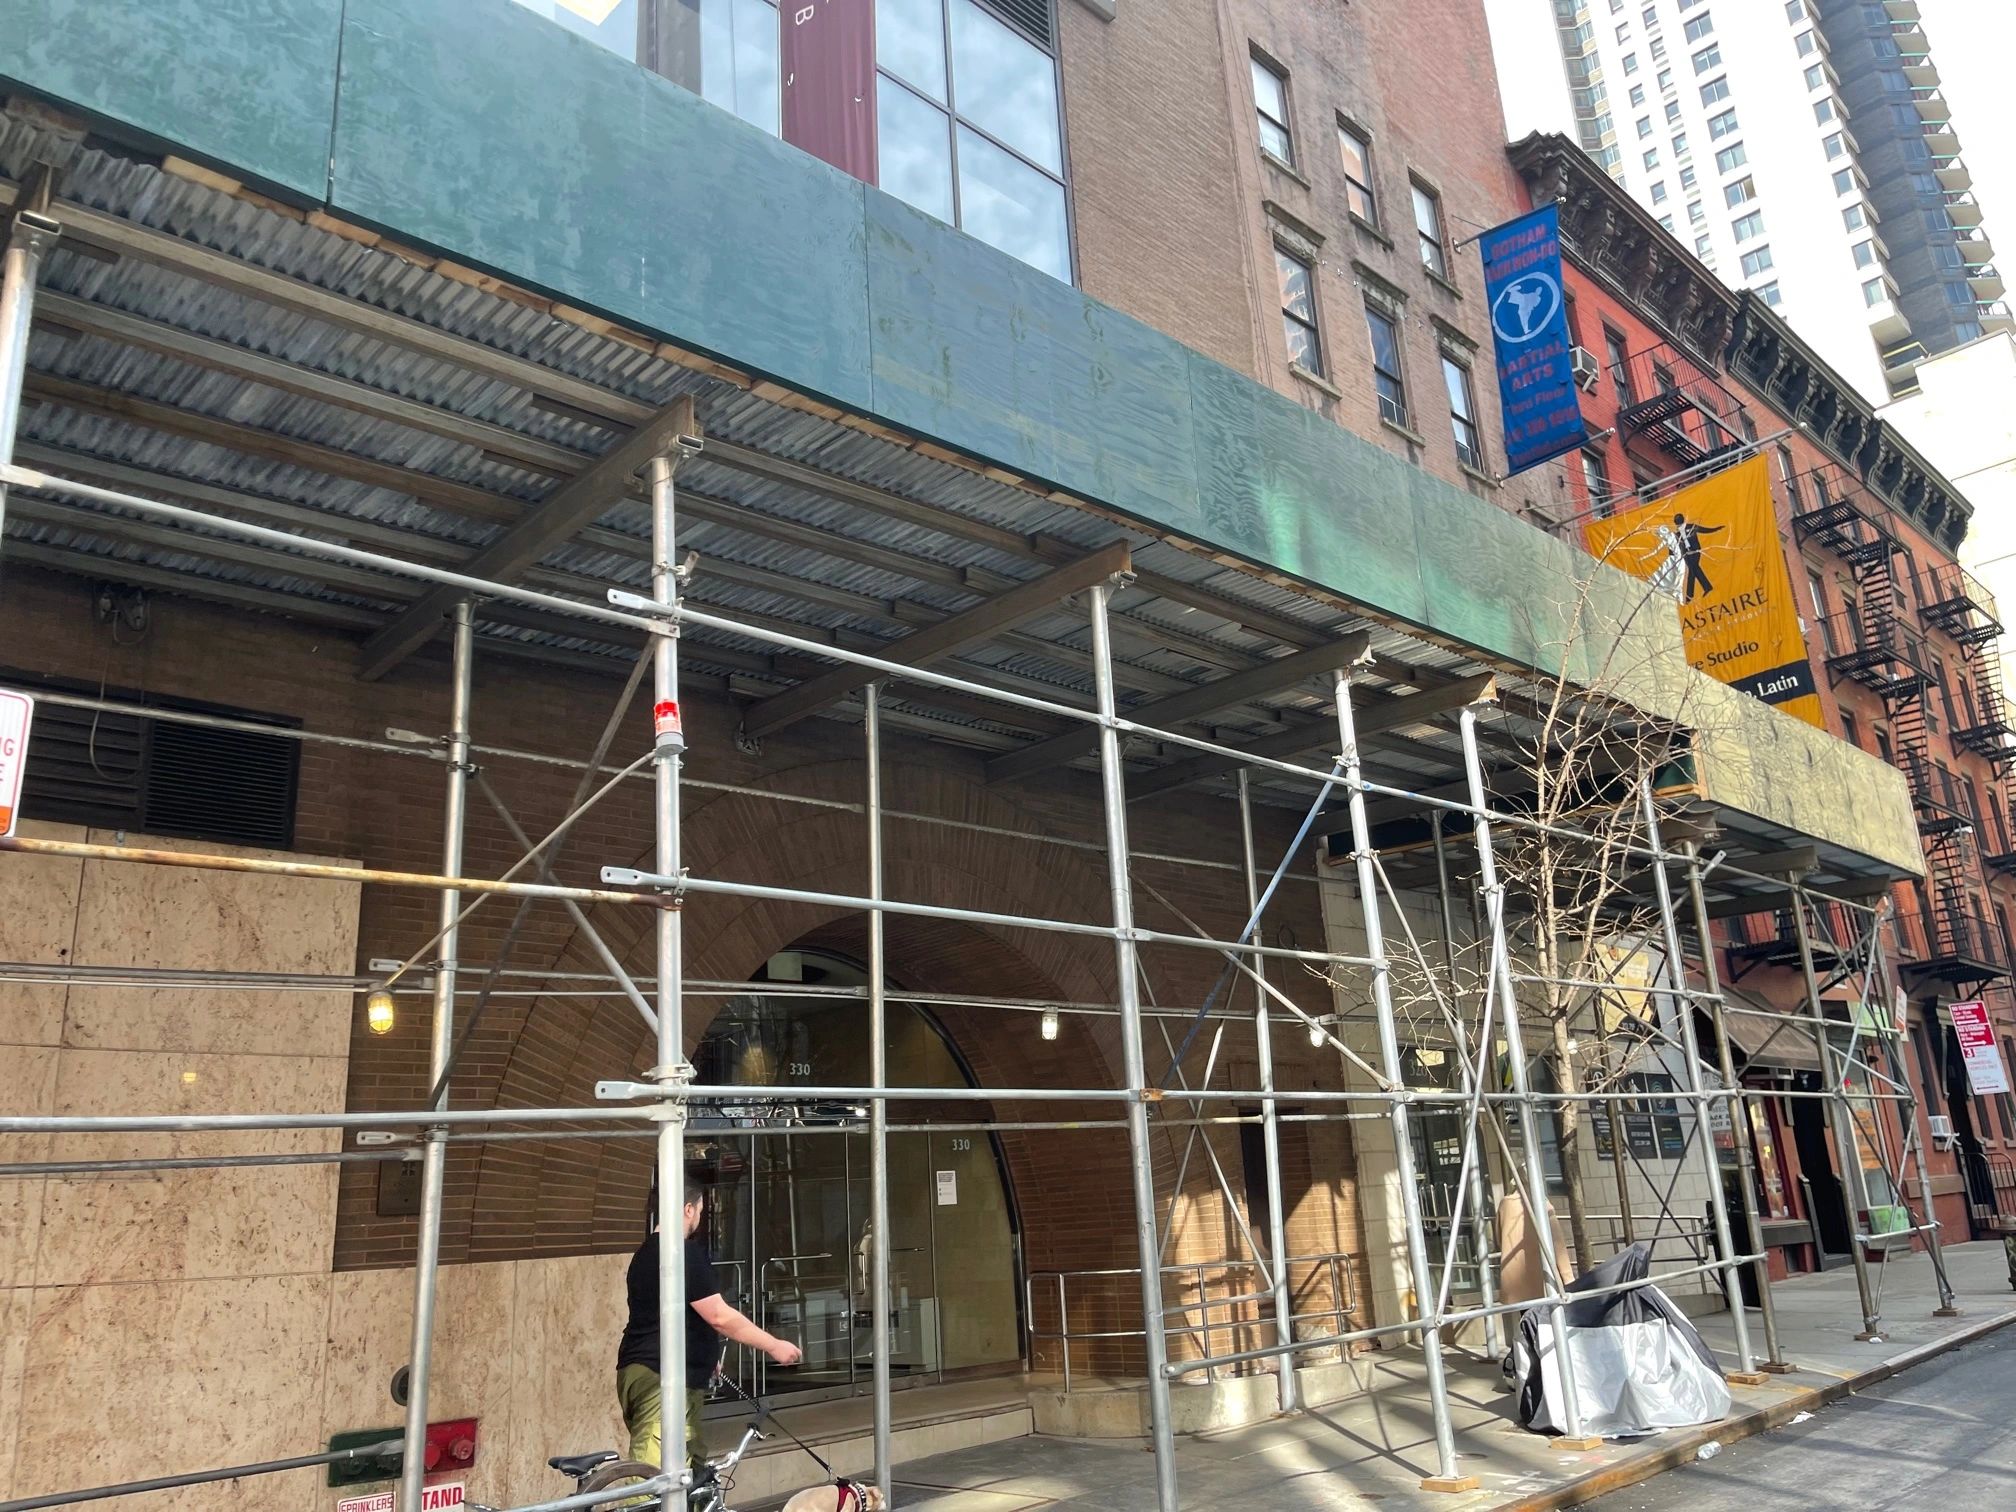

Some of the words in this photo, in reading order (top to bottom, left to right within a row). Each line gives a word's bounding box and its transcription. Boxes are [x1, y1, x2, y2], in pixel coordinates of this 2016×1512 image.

[1511, 363, 1554, 392] ARTS
[1682, 586, 1769, 634] ASTAIRE
[1706, 640, 1760, 667] Studio
[1757, 675, 1799, 697] Latin
[789, 1063, 811, 1076] 330
[952, 1139, 970, 1150] 330
[422, 1486, 463, 1511] TAND
